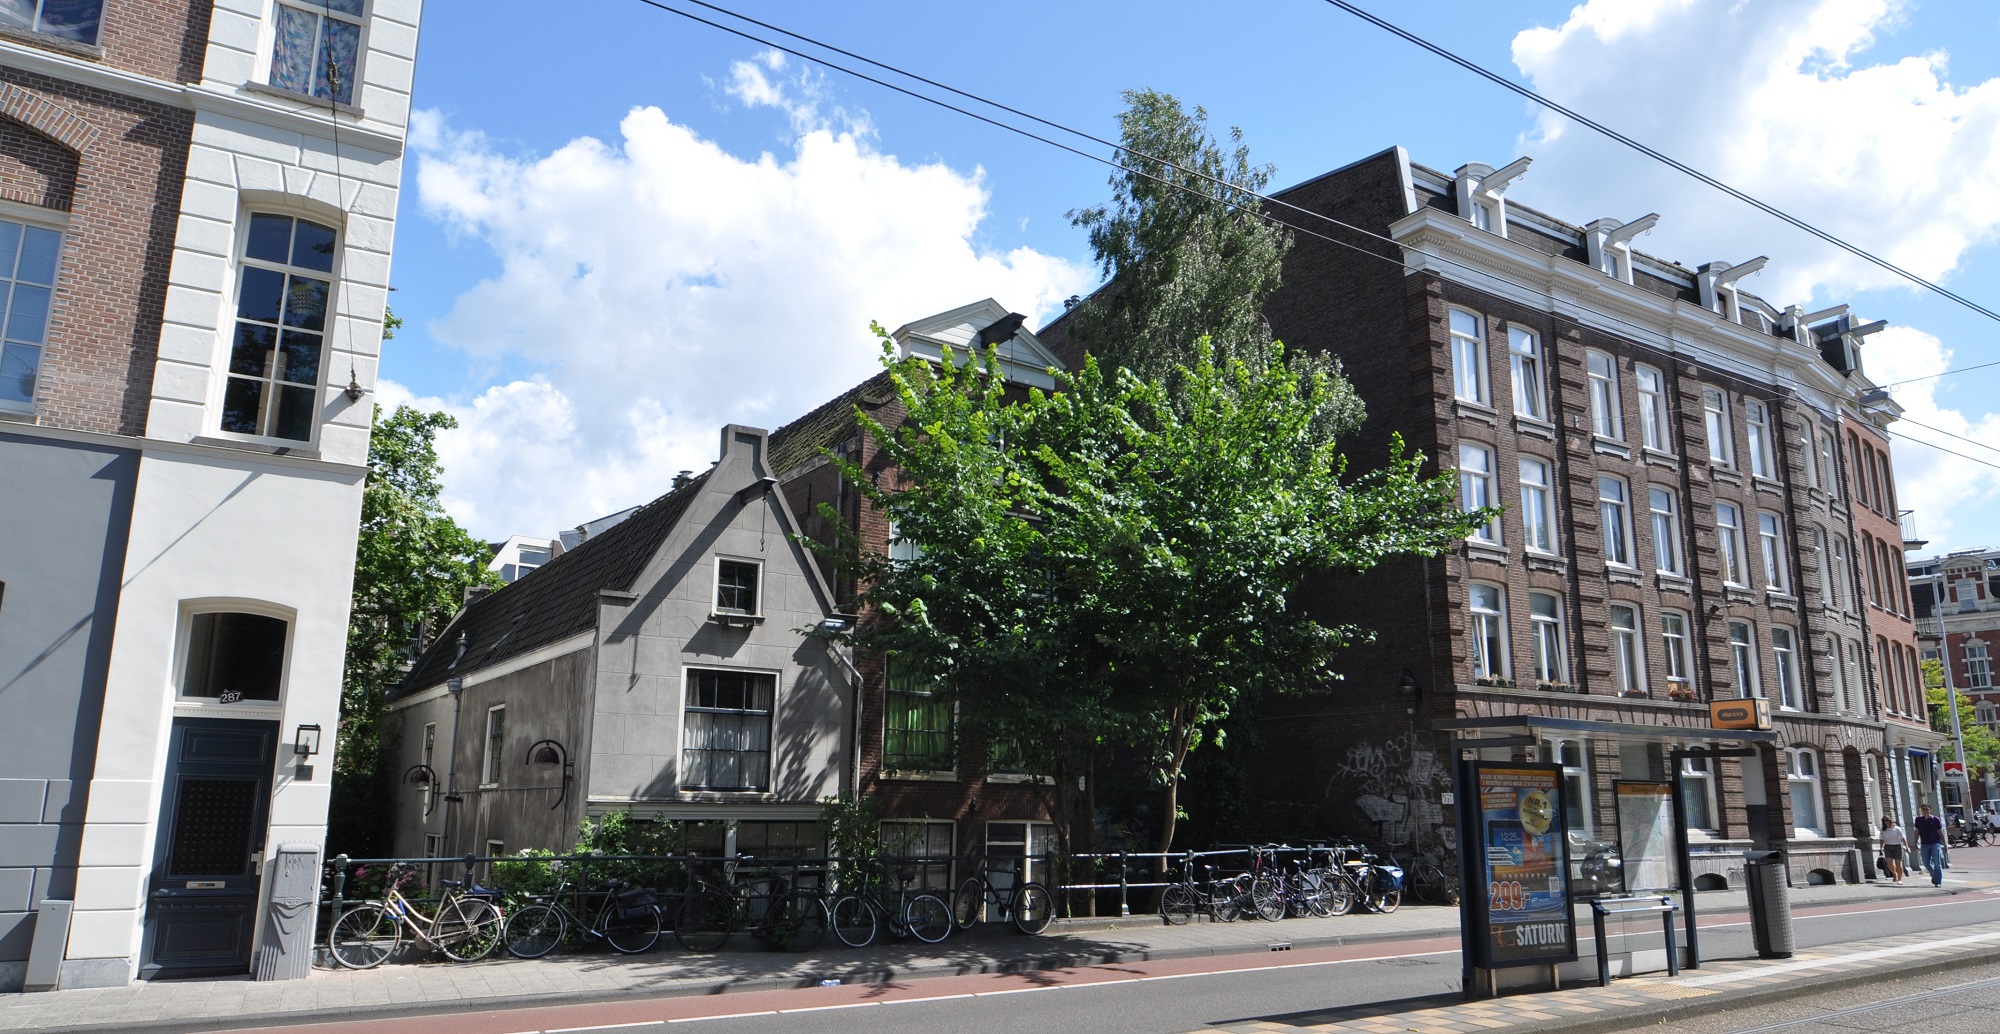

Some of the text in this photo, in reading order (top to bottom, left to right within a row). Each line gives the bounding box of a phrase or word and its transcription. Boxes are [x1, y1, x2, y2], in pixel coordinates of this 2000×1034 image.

[221, 692, 241, 702] 287
[298, 767, 311, 778] 287
[1516, 922, 1566, 946] SATURN
